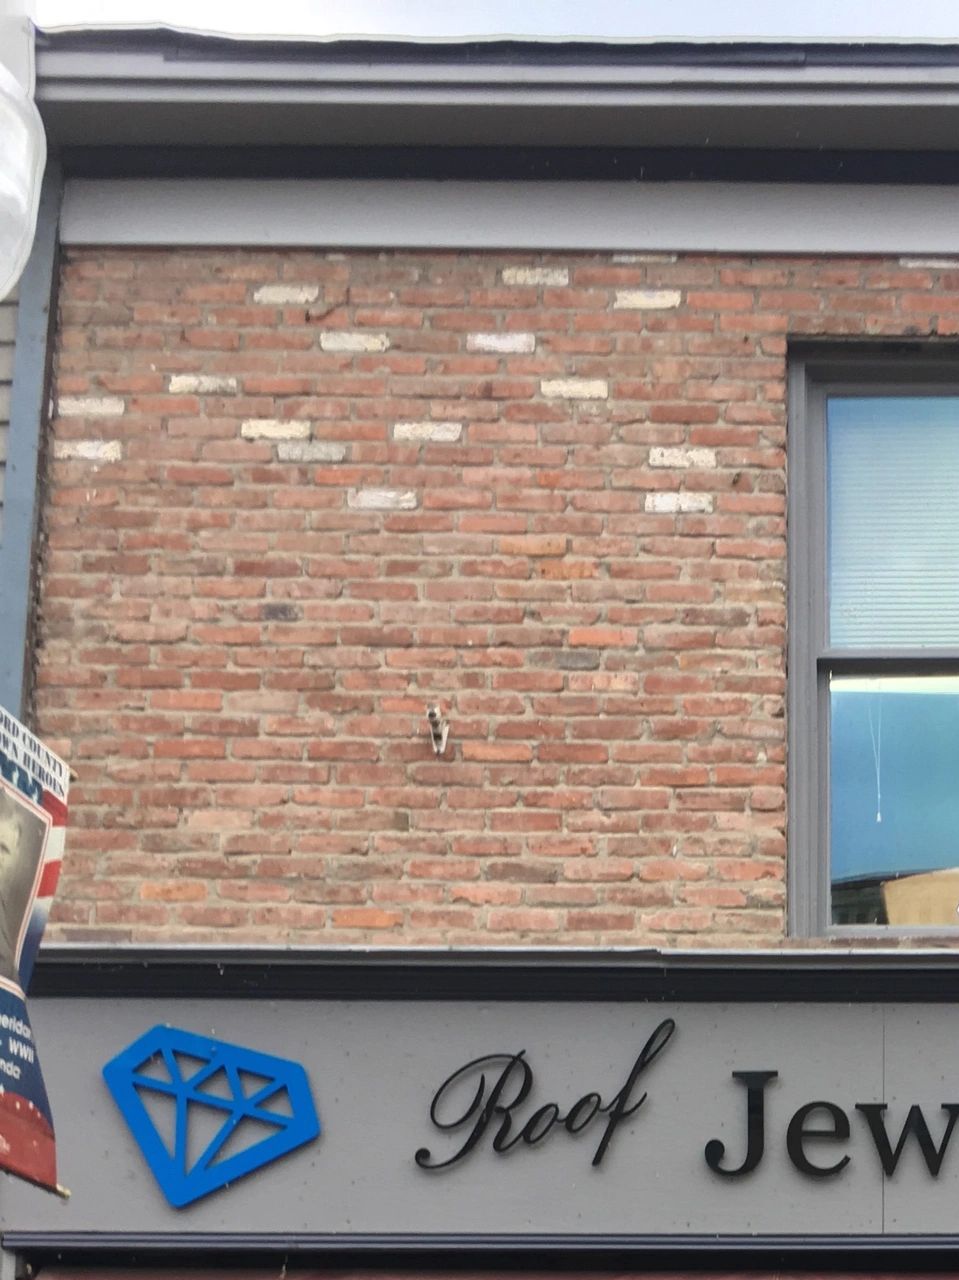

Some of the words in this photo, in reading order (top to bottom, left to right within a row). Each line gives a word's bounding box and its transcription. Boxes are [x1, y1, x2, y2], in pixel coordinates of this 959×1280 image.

[22, 731, 63, 778] COUNTY
[22, 750, 65, 797] HEROES
[8, 1035, 35, 1065] WWII
[413, 1018, 677, 1169] Roof
